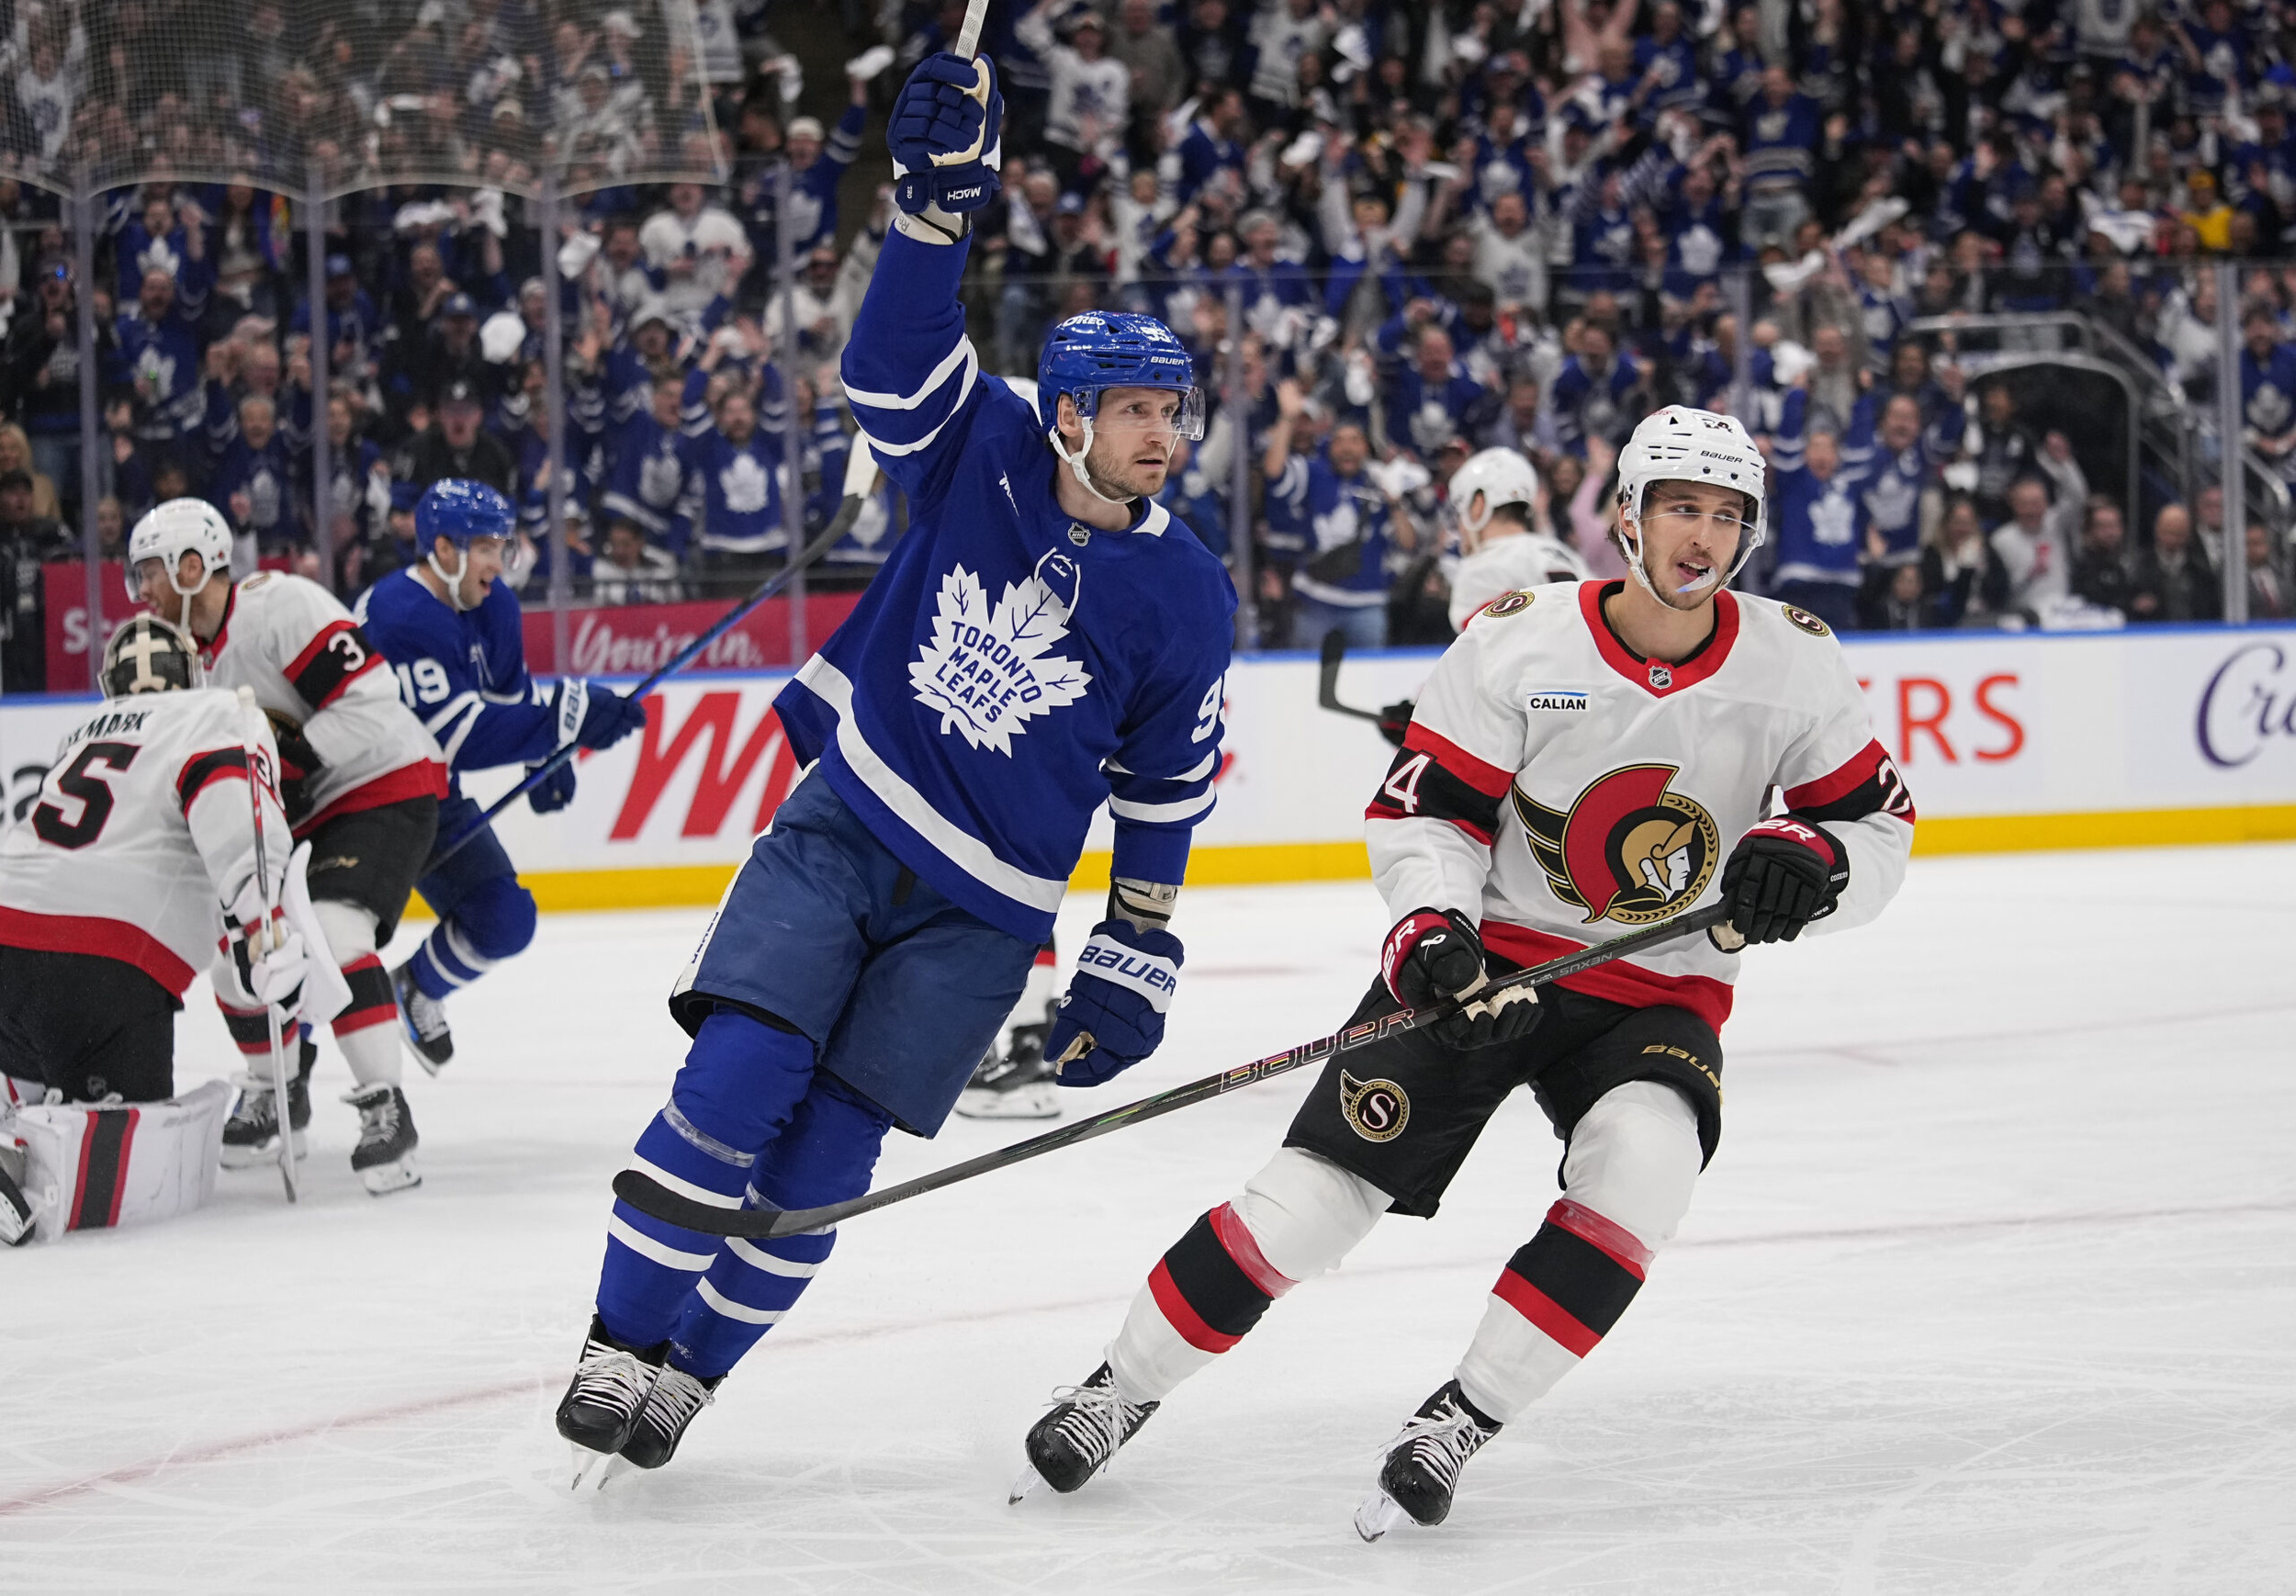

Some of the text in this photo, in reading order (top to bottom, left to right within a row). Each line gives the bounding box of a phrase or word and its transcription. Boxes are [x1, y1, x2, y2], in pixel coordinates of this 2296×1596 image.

[947, 186, 982, 201] MACH
[1062, 316, 1106, 328] OREO
[1150, 355, 1185, 366] BAUER
[1700, 450, 1743, 464] BAUER
[328, 630, 366, 672] 3
[951, 621, 1042, 703] TORONTO
[396, 658, 450, 709] 19
[934, 663, 1003, 724] LEAFS
[948, 646, 1018, 708] MAPLE
[1191, 675, 1225, 744] 9
[1530, 697, 1587, 711] CALIAN
[1860, 672, 2026, 765] RS
[1384, 753, 1431, 814] 4
[1750, 819, 1817, 842] ER
[1455, 916, 1480, 940] BAUER
[1078, 945, 1177, 997] BAUER
[1559, 951, 1614, 977] NEXUS
[1219, 1008, 1416, 1094] BAUER
[1361, 1093, 1396, 1130] S
